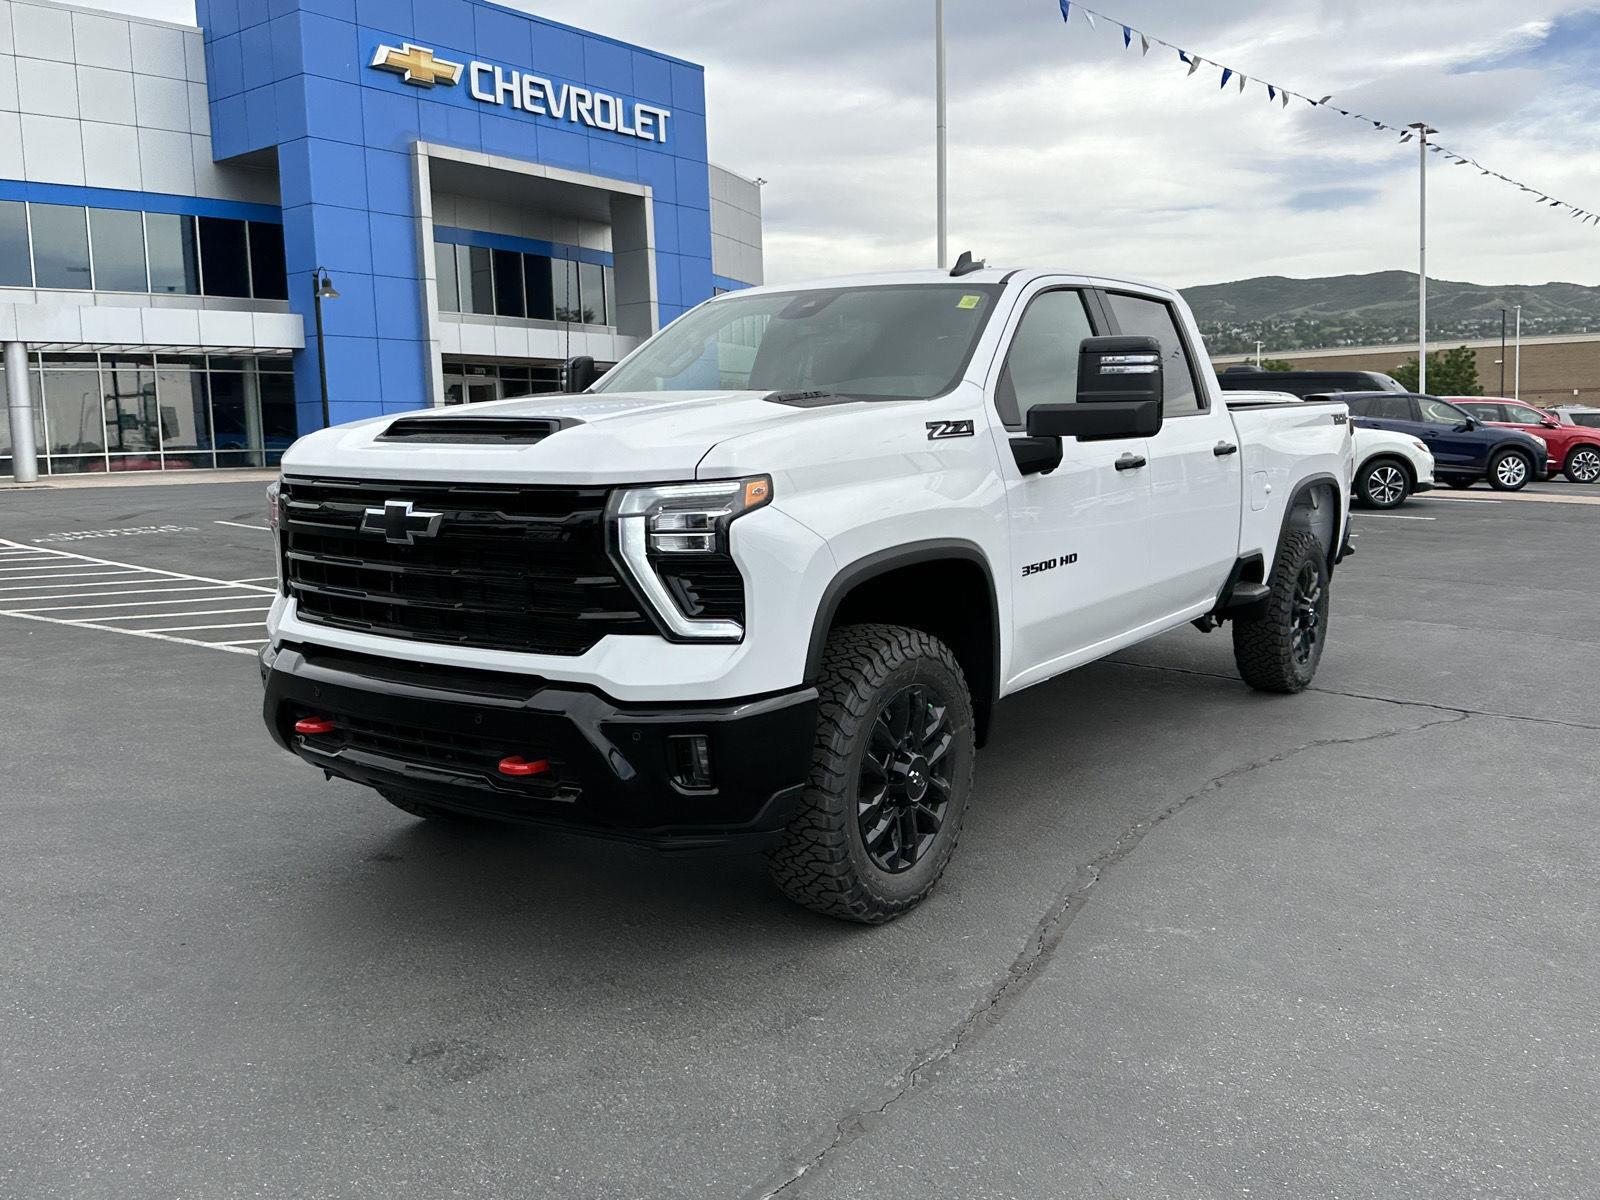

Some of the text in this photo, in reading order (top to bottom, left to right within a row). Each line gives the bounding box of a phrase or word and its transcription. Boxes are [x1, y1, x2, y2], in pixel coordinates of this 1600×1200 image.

[470, 60, 670, 142] CHEVROLET
[1021, 552, 1078, 577] 3500 HD
